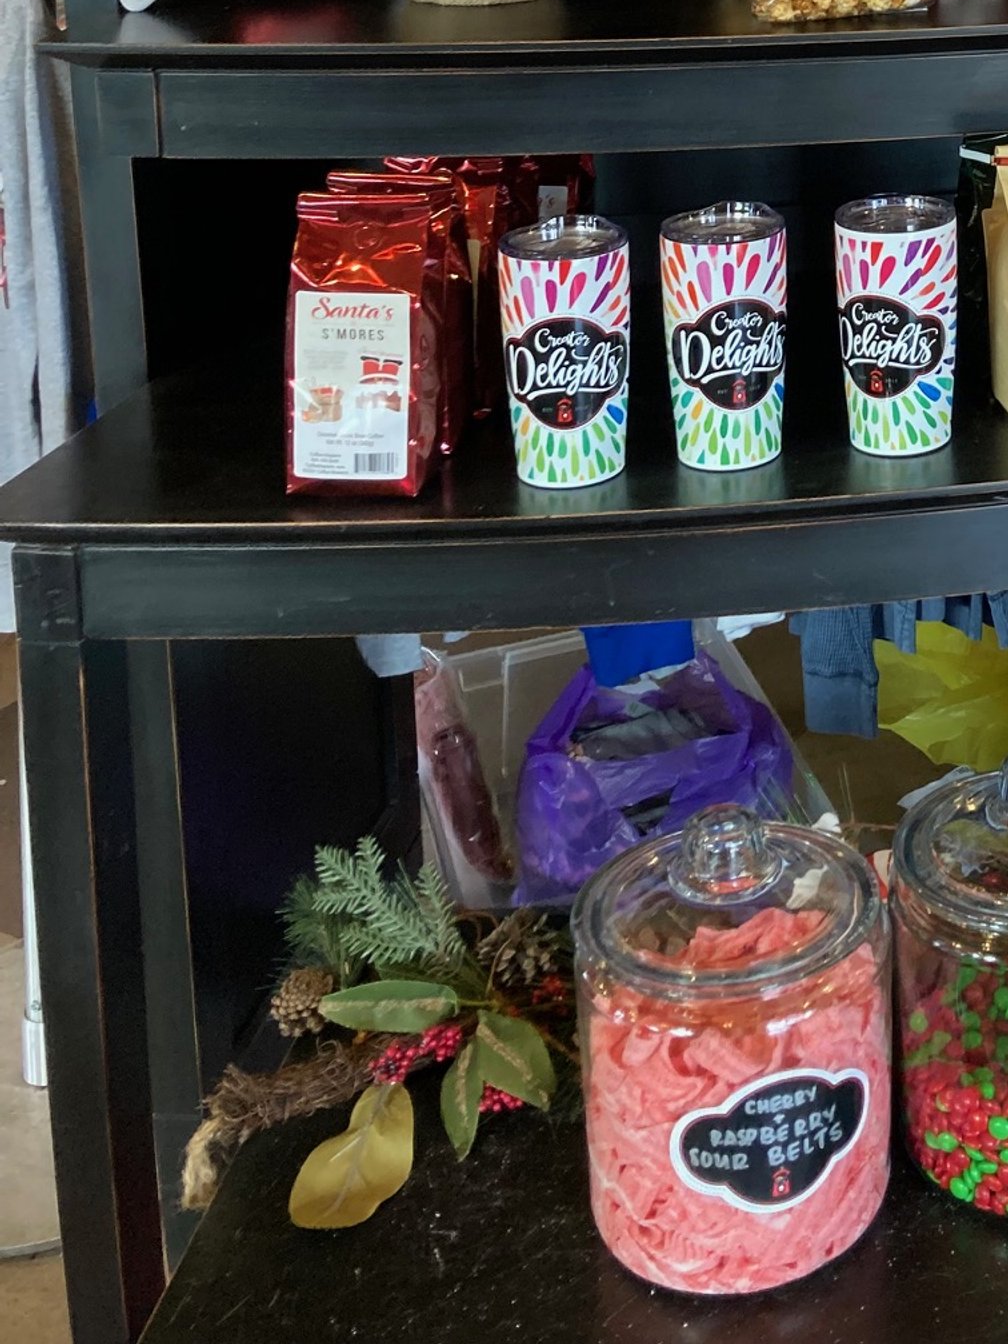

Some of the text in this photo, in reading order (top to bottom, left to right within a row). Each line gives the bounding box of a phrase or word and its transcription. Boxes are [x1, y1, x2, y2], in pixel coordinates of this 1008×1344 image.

[311, 297, 394, 321] Santa's
[711, 311, 763, 336] Creator
[852, 302, 900, 325] Creator
[322, 328, 385, 341] S'MORES
[534, 328, 591, 353] Creator
[839, 316, 939, 368] Delights
[680, 321, 786, 379] Delights
[508, 341, 624, 397] Delights
[745, 1086, 817, 1115] CHERRY
[710, 1104, 836, 1147] RASPBERRY
[689, 1121, 842, 1170] SOUR BELTS
